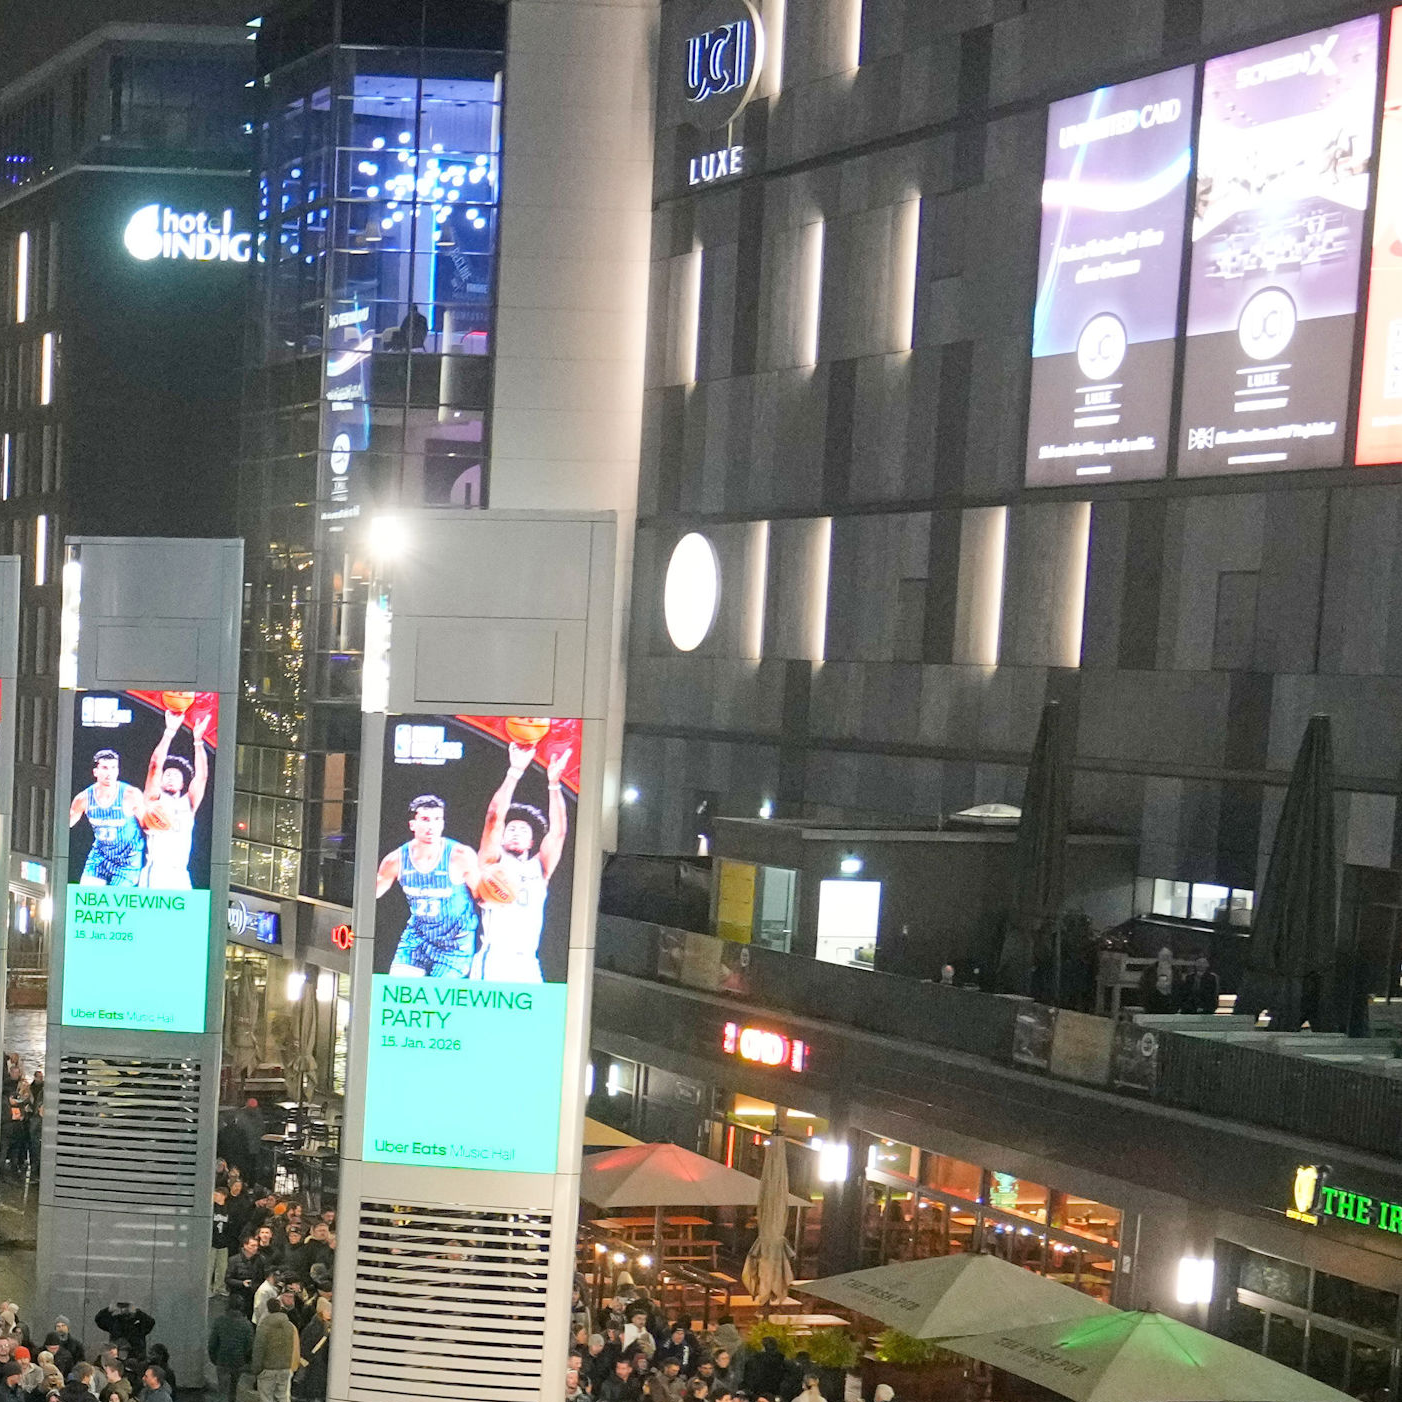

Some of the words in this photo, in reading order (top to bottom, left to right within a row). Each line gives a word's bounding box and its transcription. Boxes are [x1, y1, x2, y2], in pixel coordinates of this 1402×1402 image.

[685, 20, 748, 102] UCI
[1139, 98, 1181, 129] CARD
[688, 145, 744, 186] LUXE
[163, 206, 232, 235] hotel
[75, 892, 109, 907] NBA
[113, 893, 186, 911] VIEWING
[74, 910, 126, 925] PARTY
[109, 931, 134, 941] 2026
[382, 984, 429, 1005] NBA
[434, 987, 533, 1010] VIEWING
[70, 1008, 96, 1019] Uber
[98, 1009, 124, 1020] Eats
[381, 1008, 452, 1029] PARTY
[381, 1035, 398, 1048] 15.
[401, 1036, 426, 1049] Jan.
[428, 1038, 462, 1051] 2026
[374, 1139, 409, 1153] Uber
[412, 1141, 447, 1156] Eats
[449, 1144, 489, 1159] Music
[1321, 1186, 1373, 1226] THE
